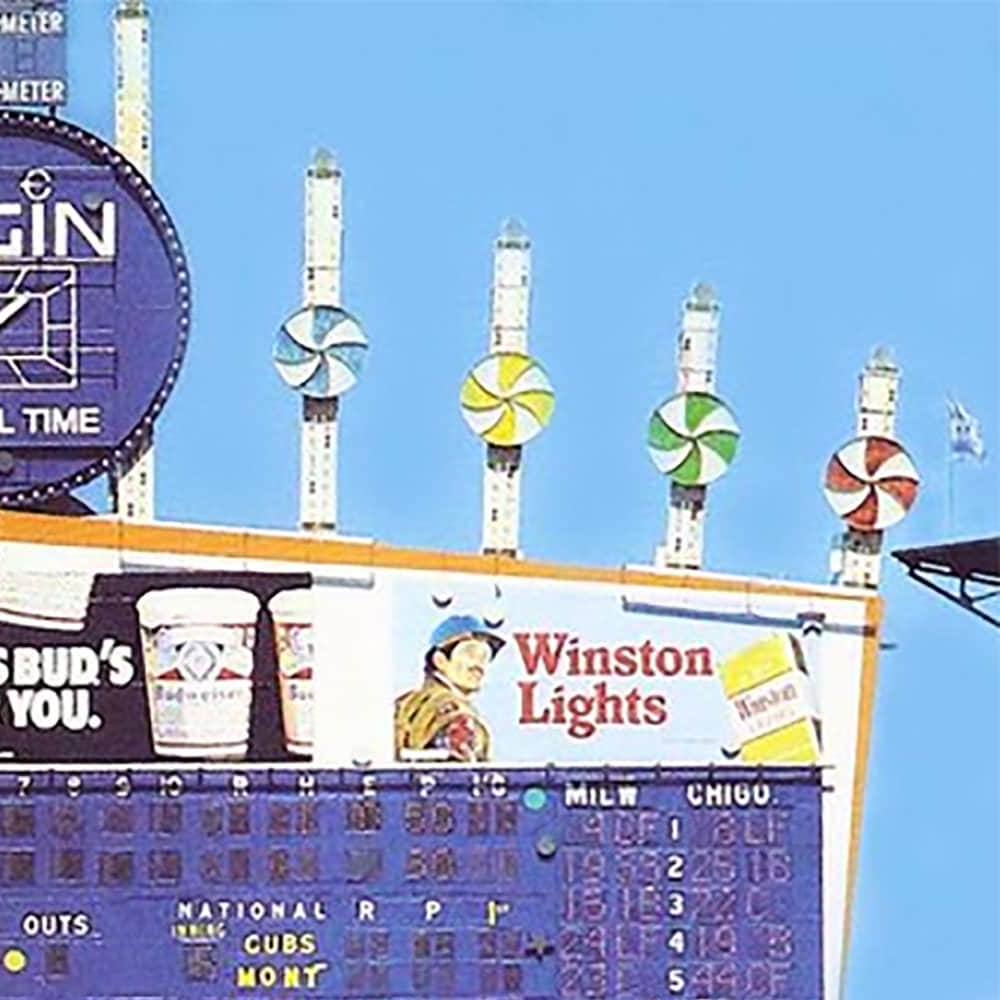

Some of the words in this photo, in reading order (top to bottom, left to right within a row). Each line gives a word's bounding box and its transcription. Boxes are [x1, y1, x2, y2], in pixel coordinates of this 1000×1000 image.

[23, 407, 101, 434] TIME
[13, 638, 134, 691] BUD'S
[517, 633, 712, 677] Winston
[6, 688, 101, 730] YOU.
[520, 682, 667, 736] Lights
[671, 819, 679, 840] 1
[668, 855, 683, 878] 2
[178, 901, 326, 921] NATIONAL
[359, 900, 374, 921] R
[425, 900, 441, 921] P
[669, 893, 684, 915] 3
[23, 914, 89, 936] OUTS
[244, 933, 316, 955] CUBS
[668, 931, 684, 953] 4
[237, 965, 319, 988] MONT
[669, 969, 685, 992] 5
